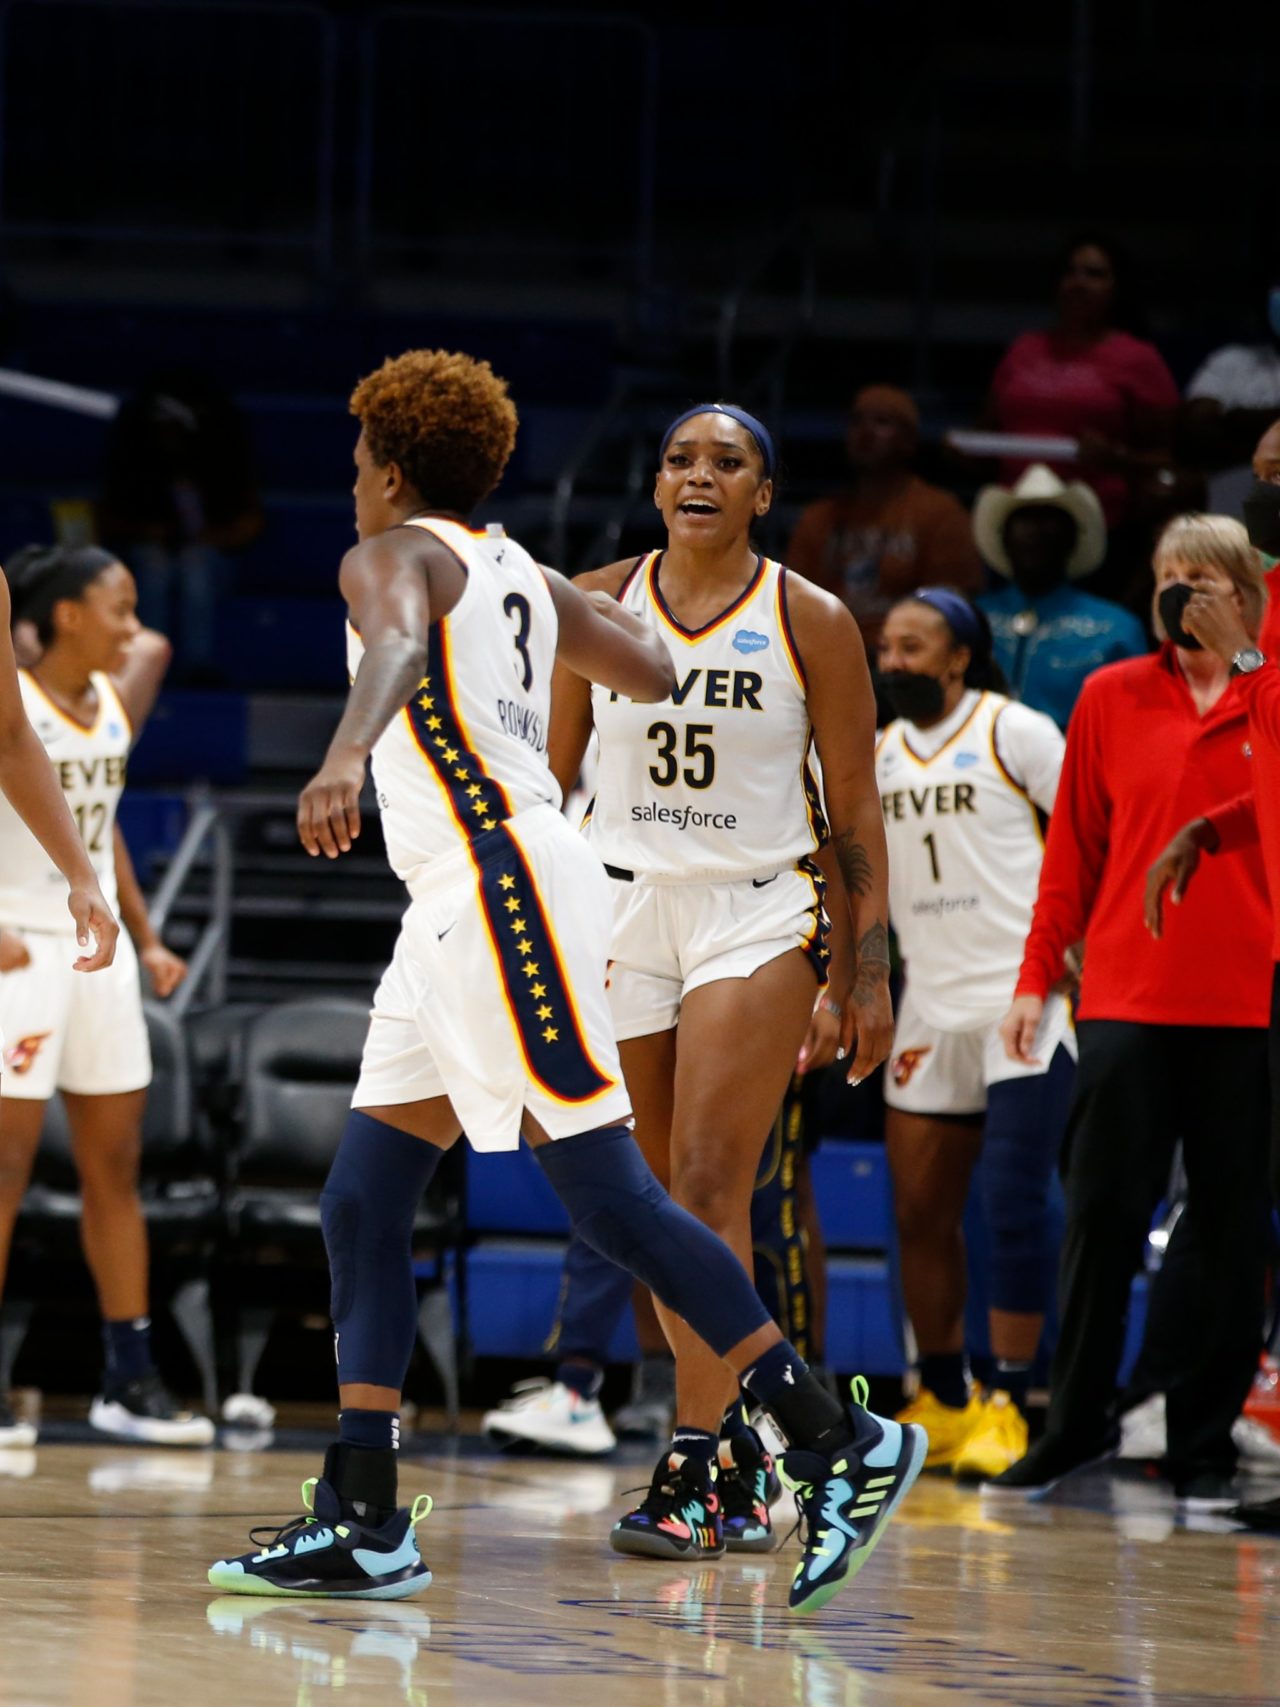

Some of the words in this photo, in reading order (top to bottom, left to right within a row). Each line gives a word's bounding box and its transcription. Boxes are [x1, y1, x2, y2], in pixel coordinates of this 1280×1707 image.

[503, 592, 533, 693] 3
[609, 668, 765, 712] VER
[646, 721, 716, 791] 35
[74, 802, 107, 852] 12
[631, 801, 738, 831] salesforce
[881, 783, 977, 825] FEVER
[923, 831, 941, 884] 1
